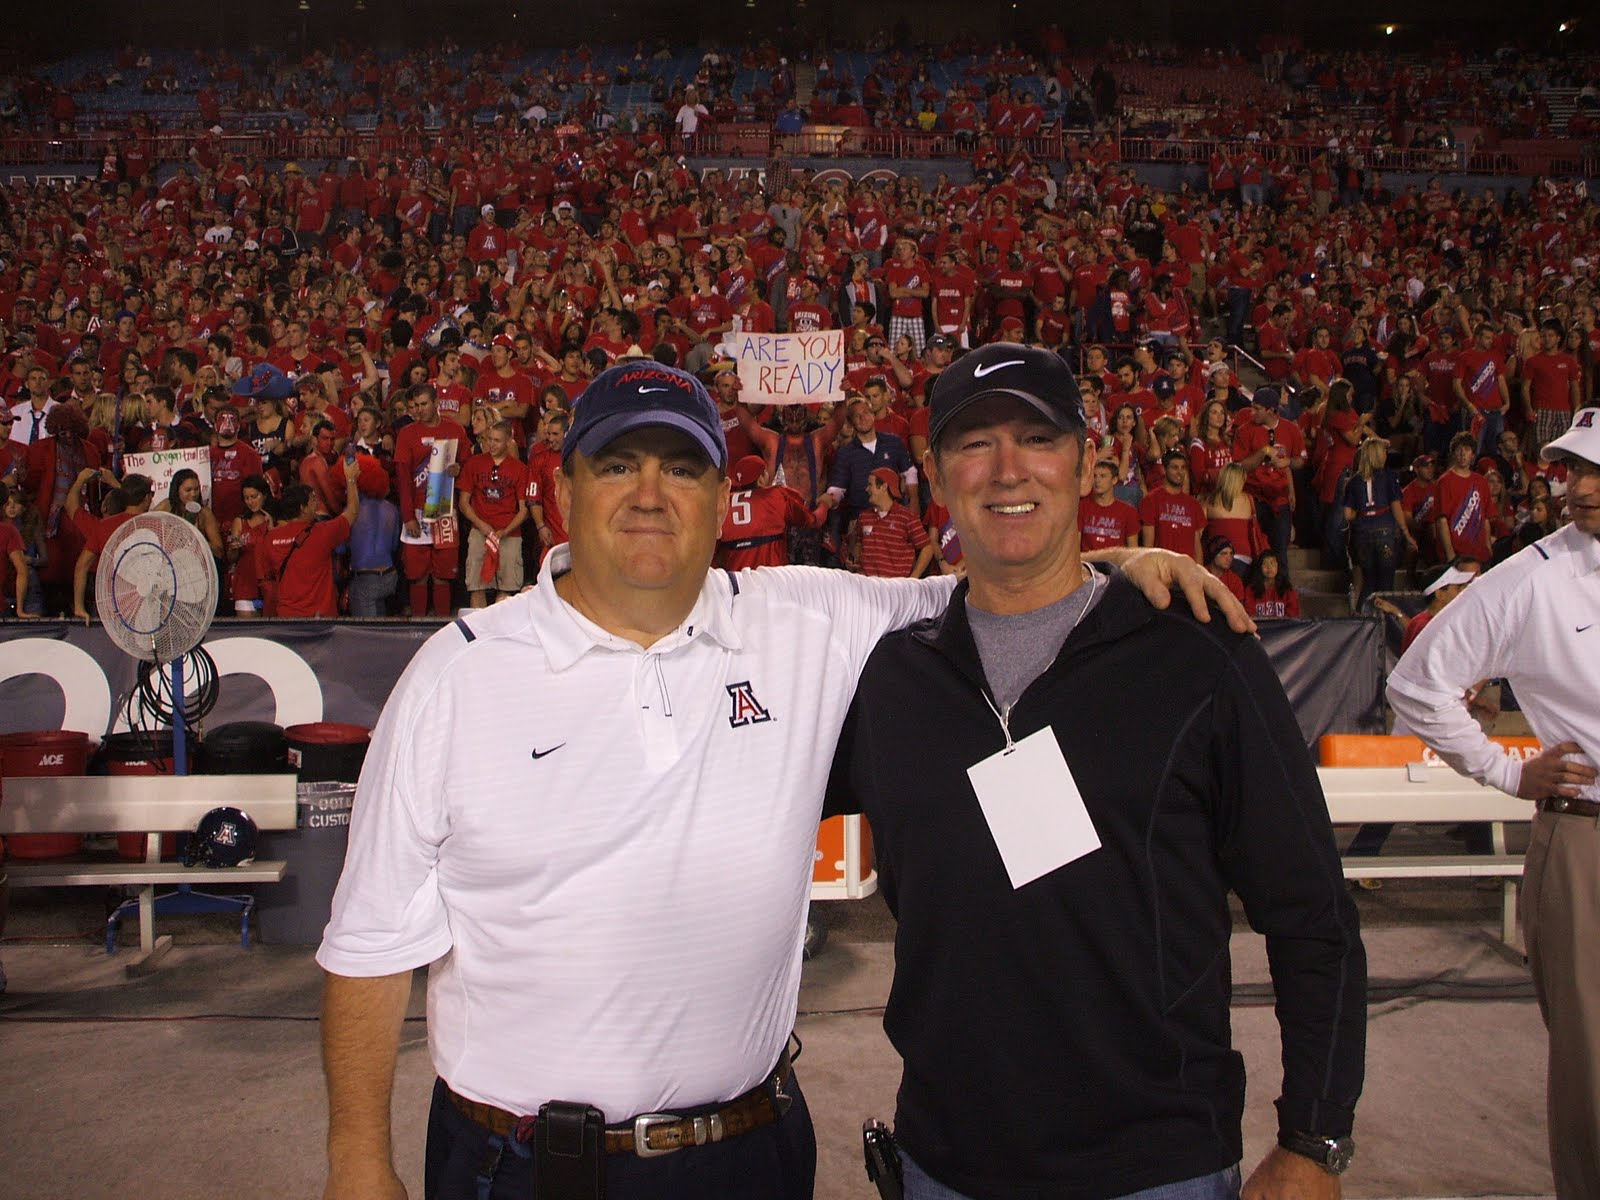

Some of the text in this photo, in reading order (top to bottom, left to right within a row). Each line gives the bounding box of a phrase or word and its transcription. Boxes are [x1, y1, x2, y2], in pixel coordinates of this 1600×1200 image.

[741, 335, 842, 362] ARE YOU
[615, 370, 692, 394] ARIZONA
[759, 358, 841, 395] READY
[126, 454, 145, 467] The
[731, 489, 752, 526] 5
[441, 517, 454, 543] OUT
[726, 680, 771, 729] A
[39, 754, 64, 766] ACE
[213, 821, 237, 847] A
